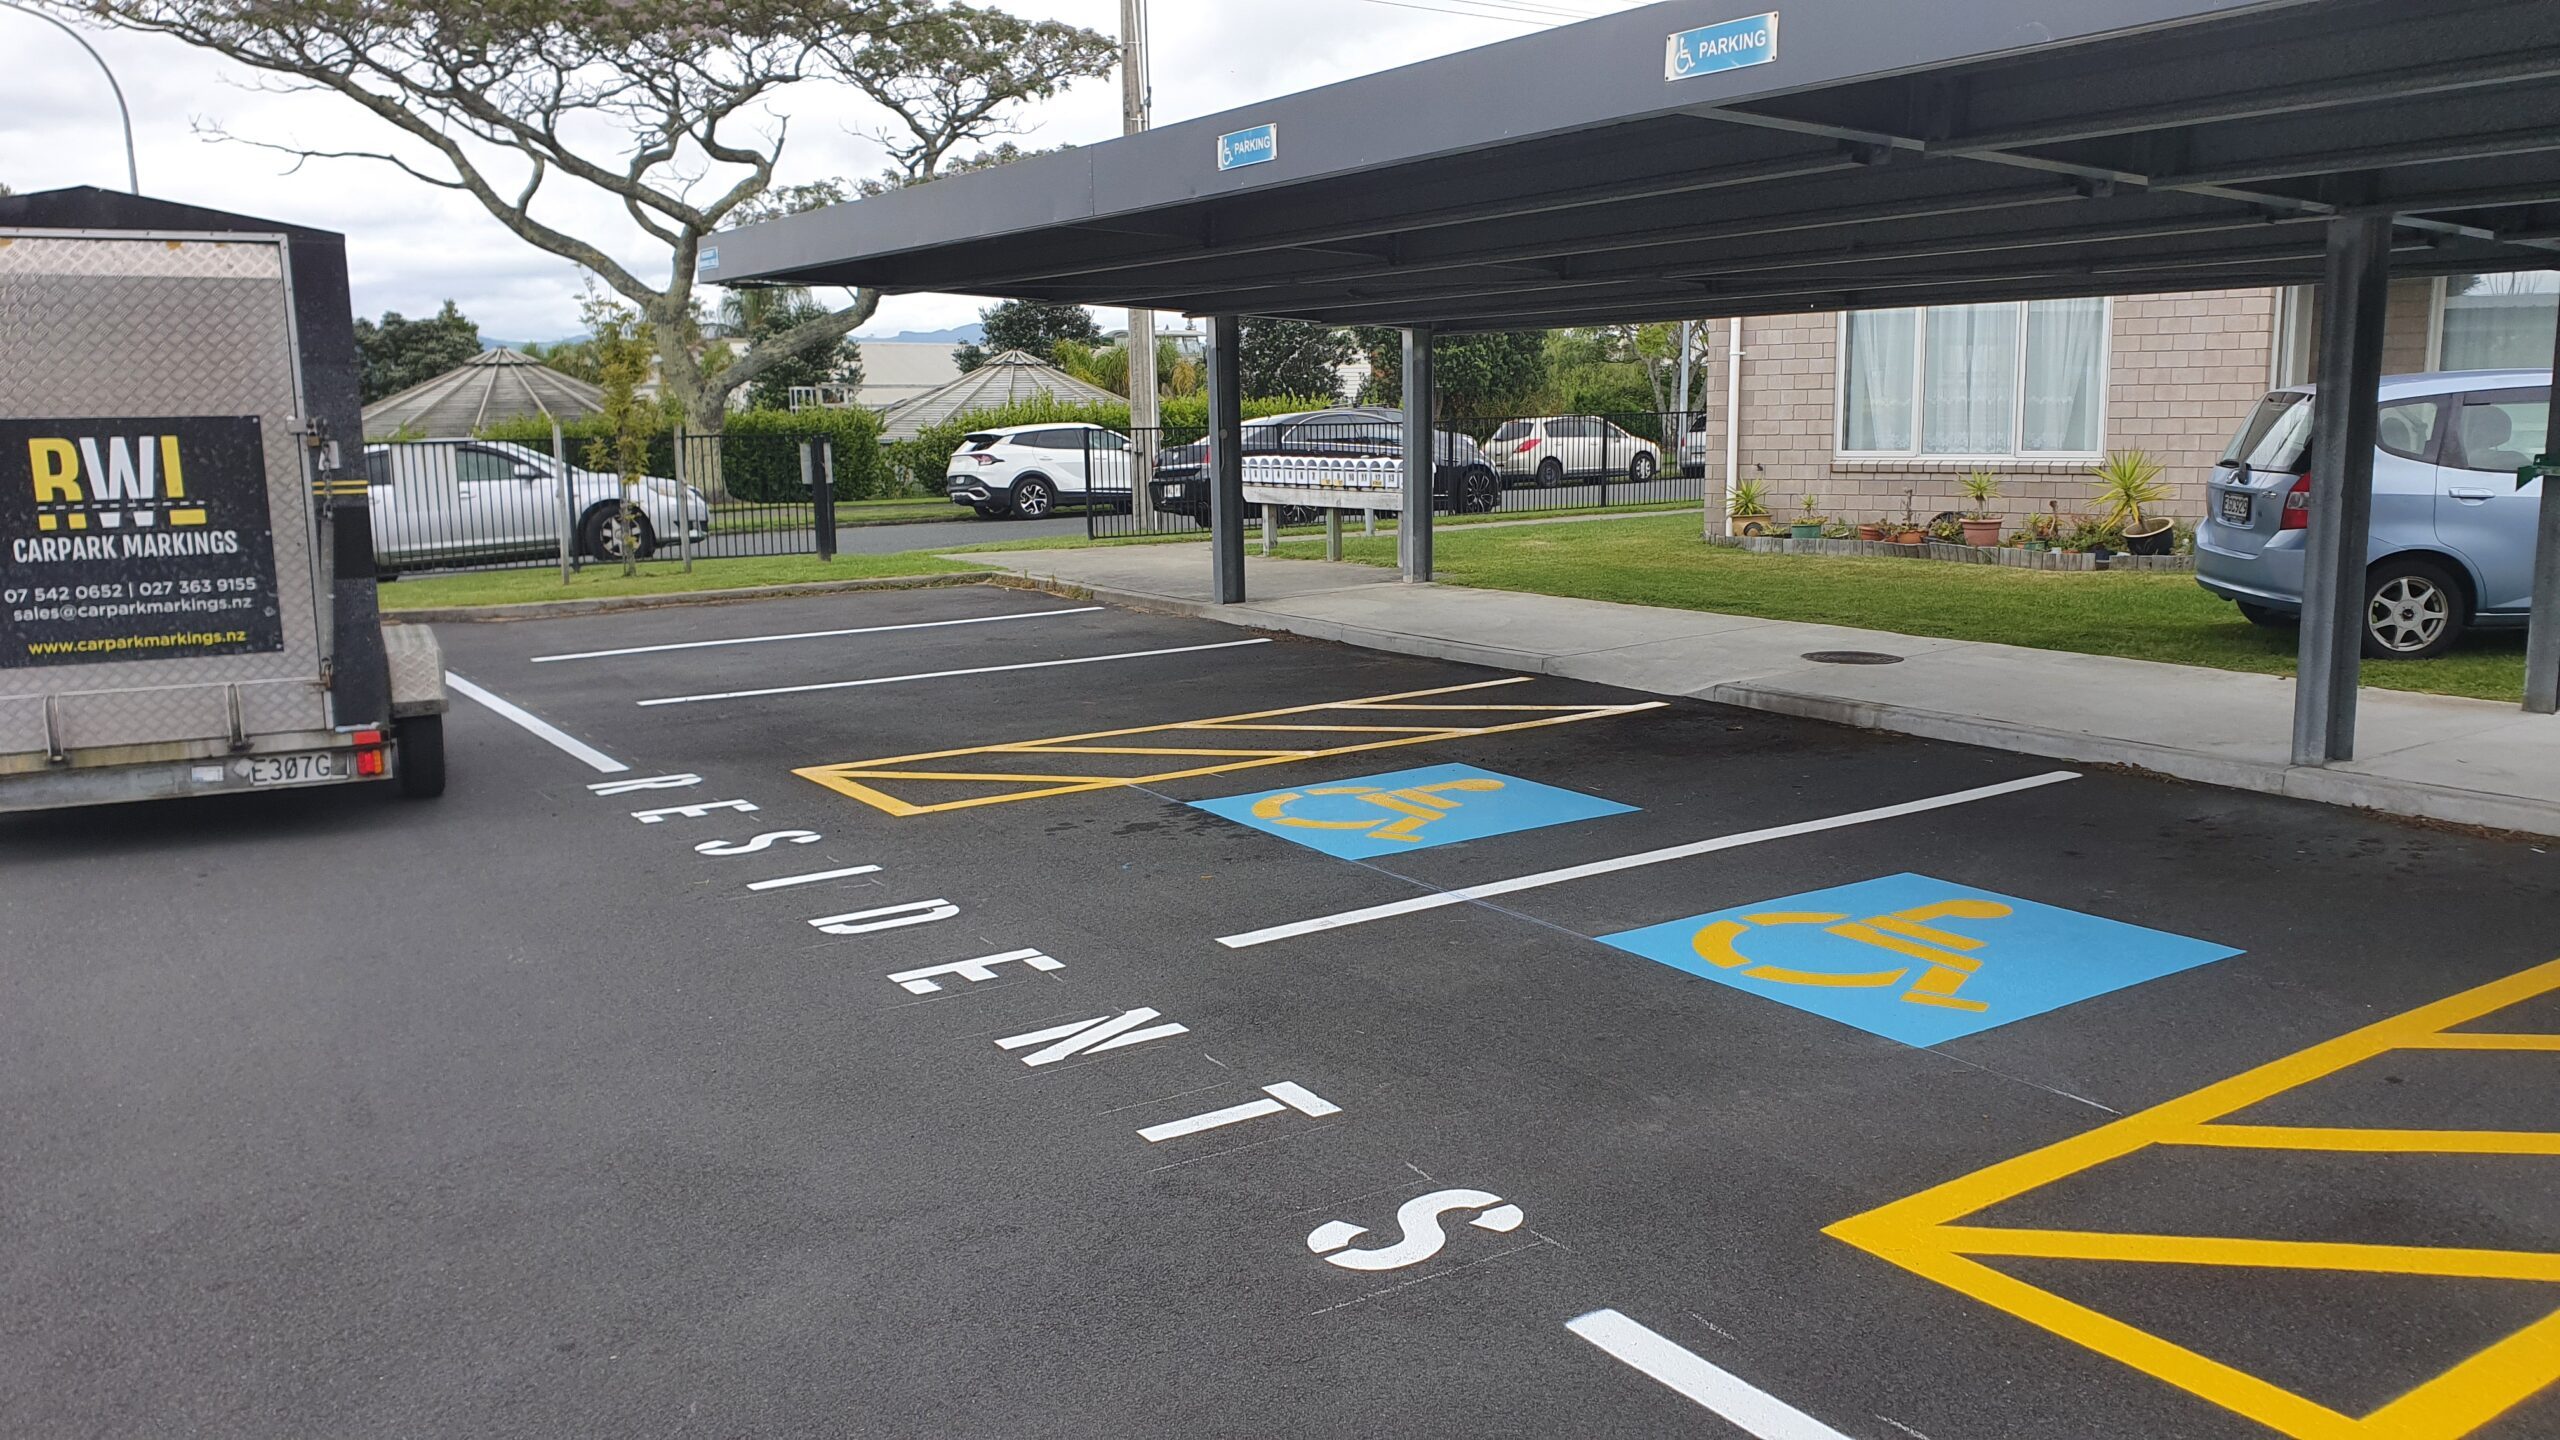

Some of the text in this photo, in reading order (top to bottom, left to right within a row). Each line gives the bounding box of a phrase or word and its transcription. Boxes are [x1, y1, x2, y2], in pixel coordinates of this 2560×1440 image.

[1699, 29, 1767, 59] PARKING
[1234, 135, 1271, 156] PARKING
[13, 529, 238, 563] CARPARK MARKINGS
[4, 588, 28, 603] 07
[34, 586, 70, 602] 542
[75, 583, 122, 600] 0652
[139, 581, 173, 596] 027
[179, 579, 212, 594] 363
[217, 577, 257, 592] 9155
[13, 597, 252, 622] sales@carparkmarkings.nz
[28, 630, 247, 655] www.carparkmarkings.nz
[251, 753, 330, 782] E307G
[586, 773, 1524, 1270] RESIDENTS
